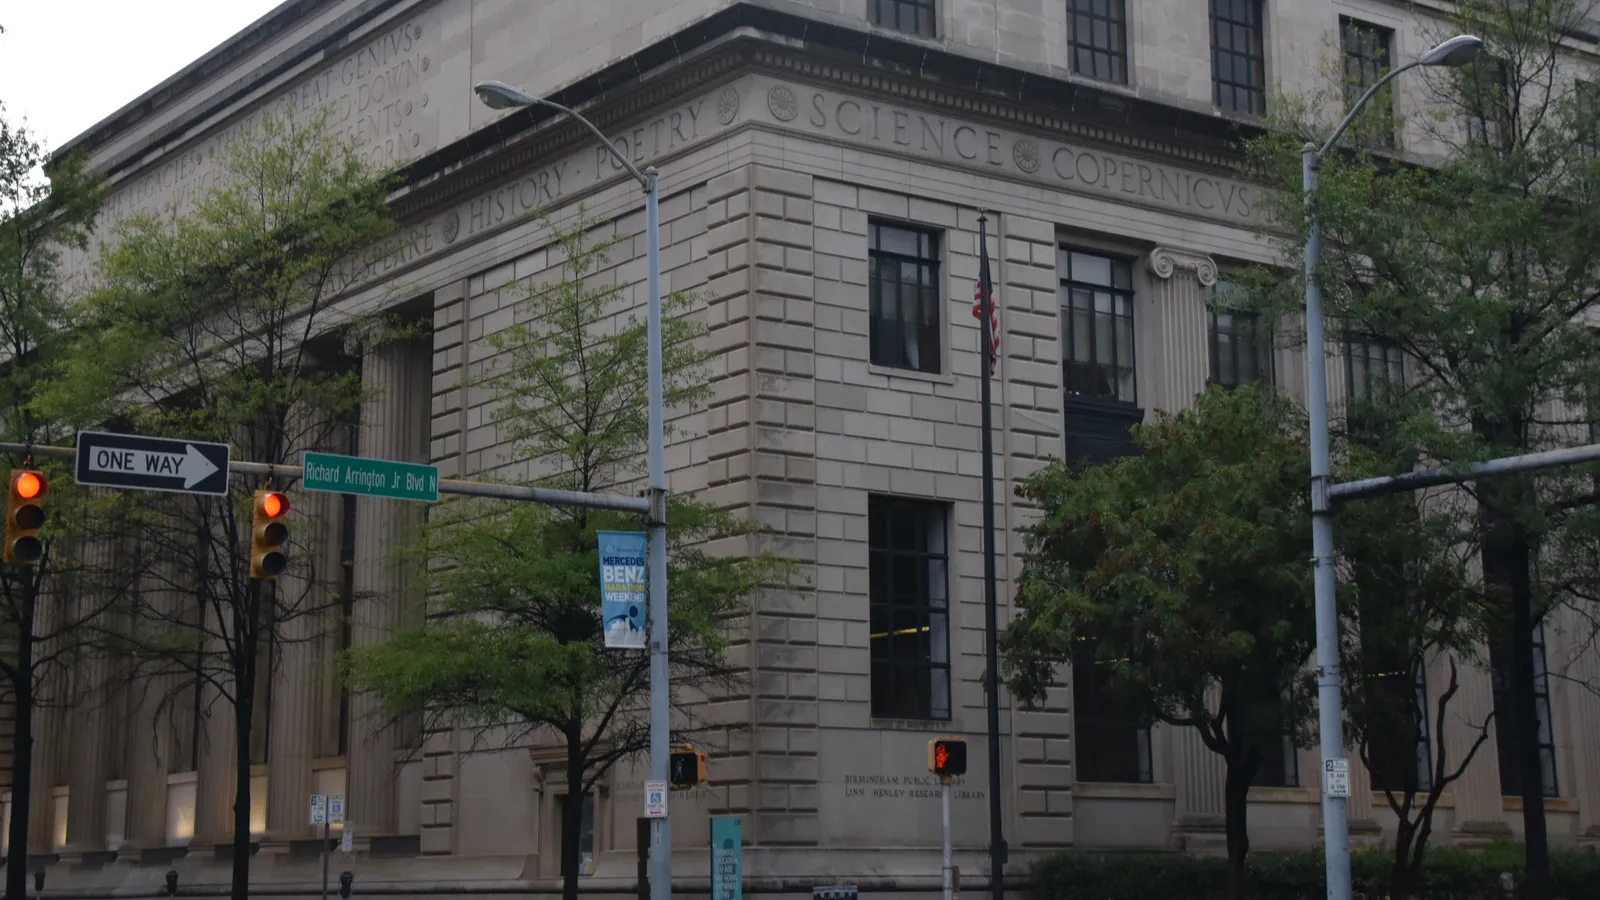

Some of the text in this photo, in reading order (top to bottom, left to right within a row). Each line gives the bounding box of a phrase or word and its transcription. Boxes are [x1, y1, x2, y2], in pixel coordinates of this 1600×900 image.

[357, 53, 420, 113] DOWN
[130, 149, 196, 208] LEGACIES
[275, 71, 333, 120] GREAT
[341, 23, 413, 86] GENIVS
[468, 103, 703, 234] HISTORY POETRY
[809, 93, 1004, 167] SCIENCE
[1051, 146, 1250, 219] COPERNICVS
[97, 450, 185, 475] ONE WAY
[306, 462, 436, 496] Richard Arrington Jr Blvd N
[602, 556, 645, 566] MERCEDES
[603, 566, 645, 583] BENZ
[604, 592, 645, 602] WEEKEND
[845, 775, 965, 787] BIRMINGHAM PUBLIC LARY
[845, 787, 865, 797] LINN
[873, 788, 905, 799] HENLEY
[954, 791, 985, 800] LIBRARY
